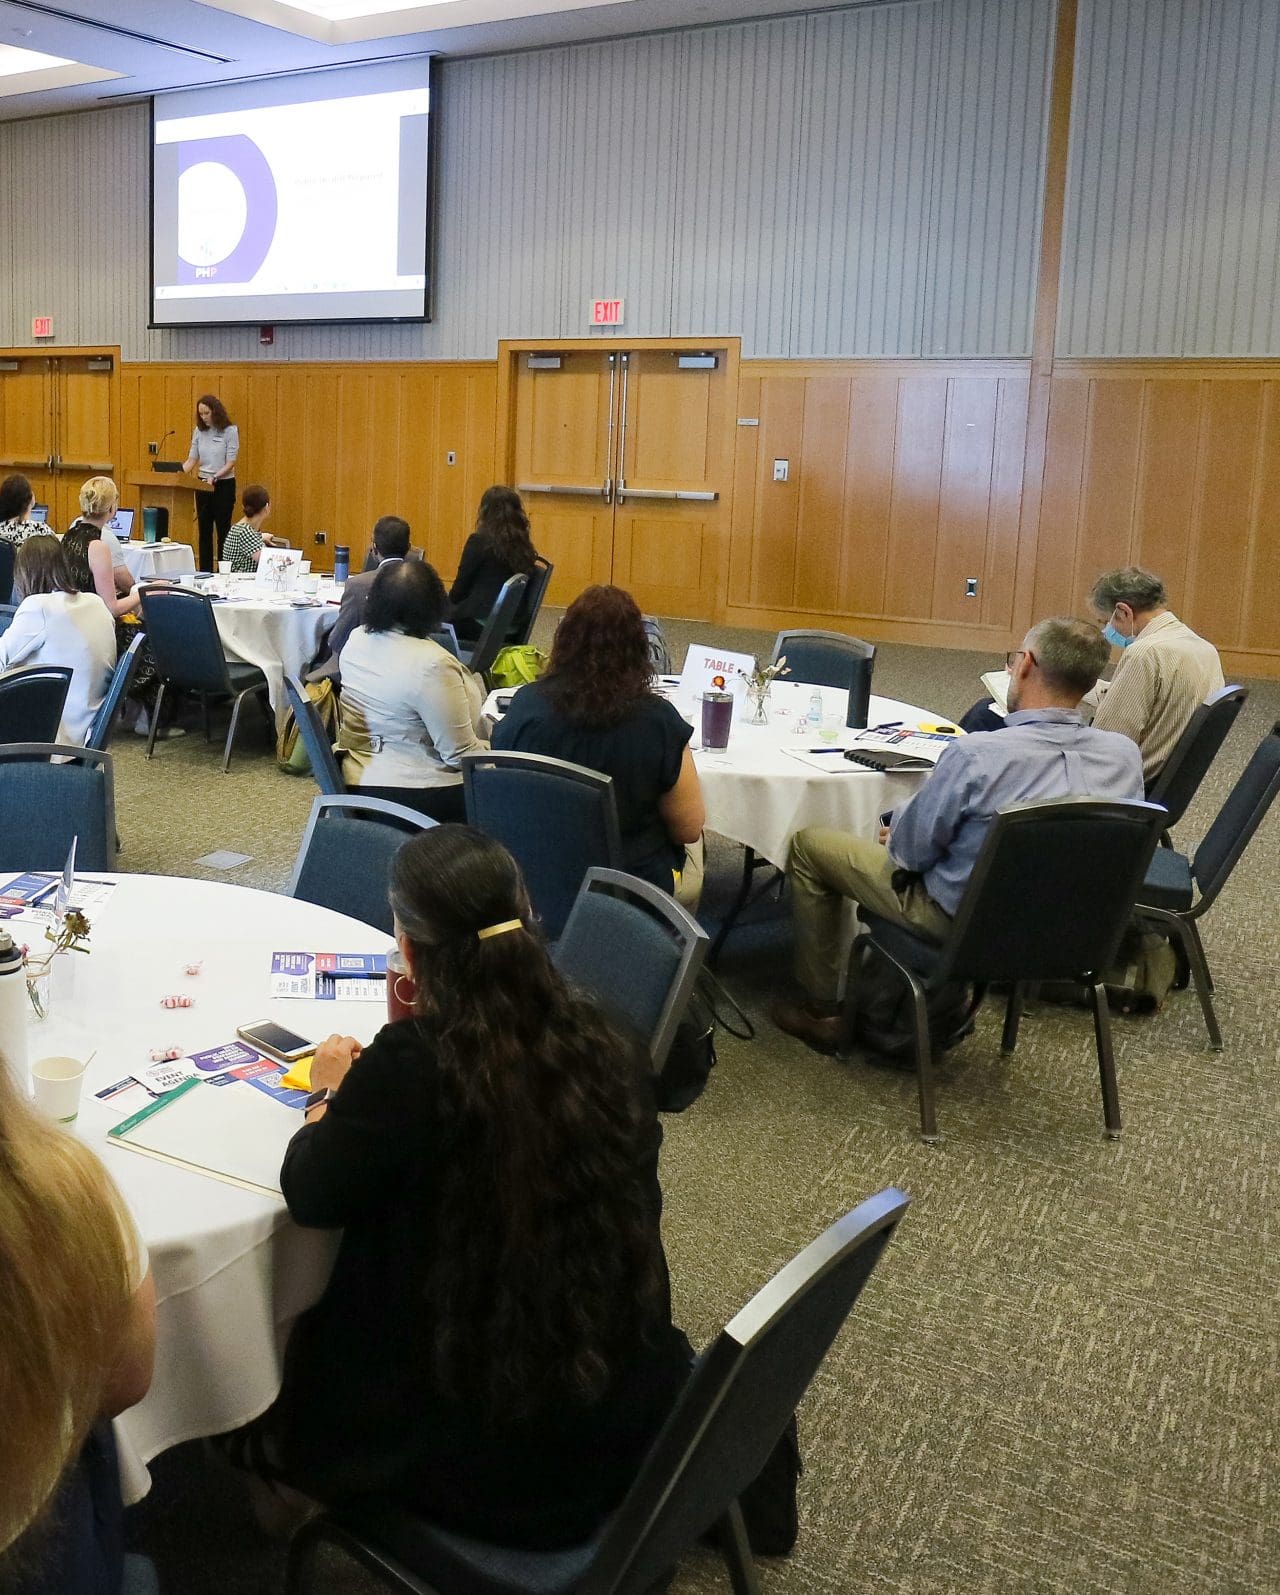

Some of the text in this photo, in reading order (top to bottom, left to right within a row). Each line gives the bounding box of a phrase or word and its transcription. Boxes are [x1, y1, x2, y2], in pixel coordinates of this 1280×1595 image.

[195, 267, 217, 278] PHP
[595, 301, 620, 322] EXIT
[35, 318, 51, 335] EXIT
[704, 657, 735, 674] TABLE
[155, 1071, 184, 1082] EVENT
[162, 1073, 200, 1087] AGENDA
